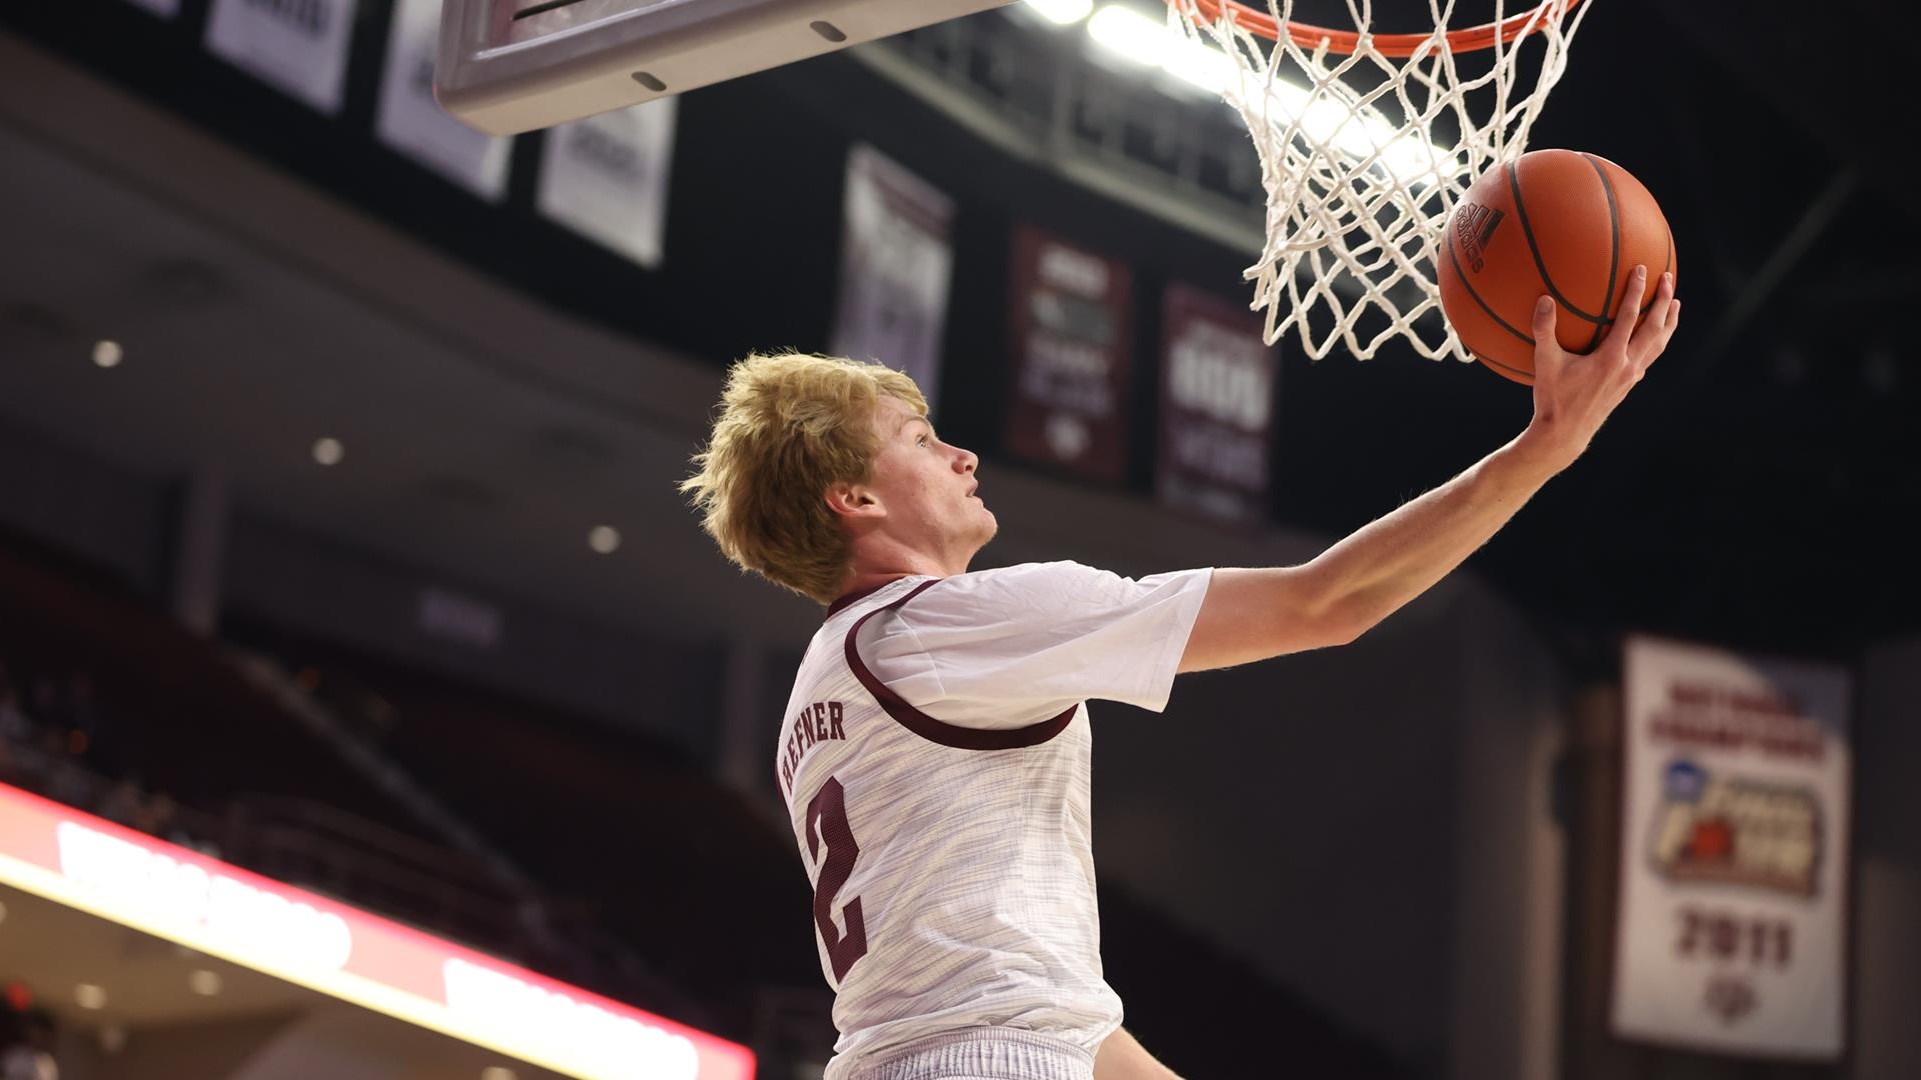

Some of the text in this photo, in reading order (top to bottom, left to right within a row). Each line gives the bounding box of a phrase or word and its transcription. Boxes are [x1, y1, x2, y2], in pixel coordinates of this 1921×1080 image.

[1456, 205, 1484, 273] adidas
[783, 701, 846, 795] HEFNER
[806, 775, 867, 985] 2
[1675, 906, 1794, 970] 2011
